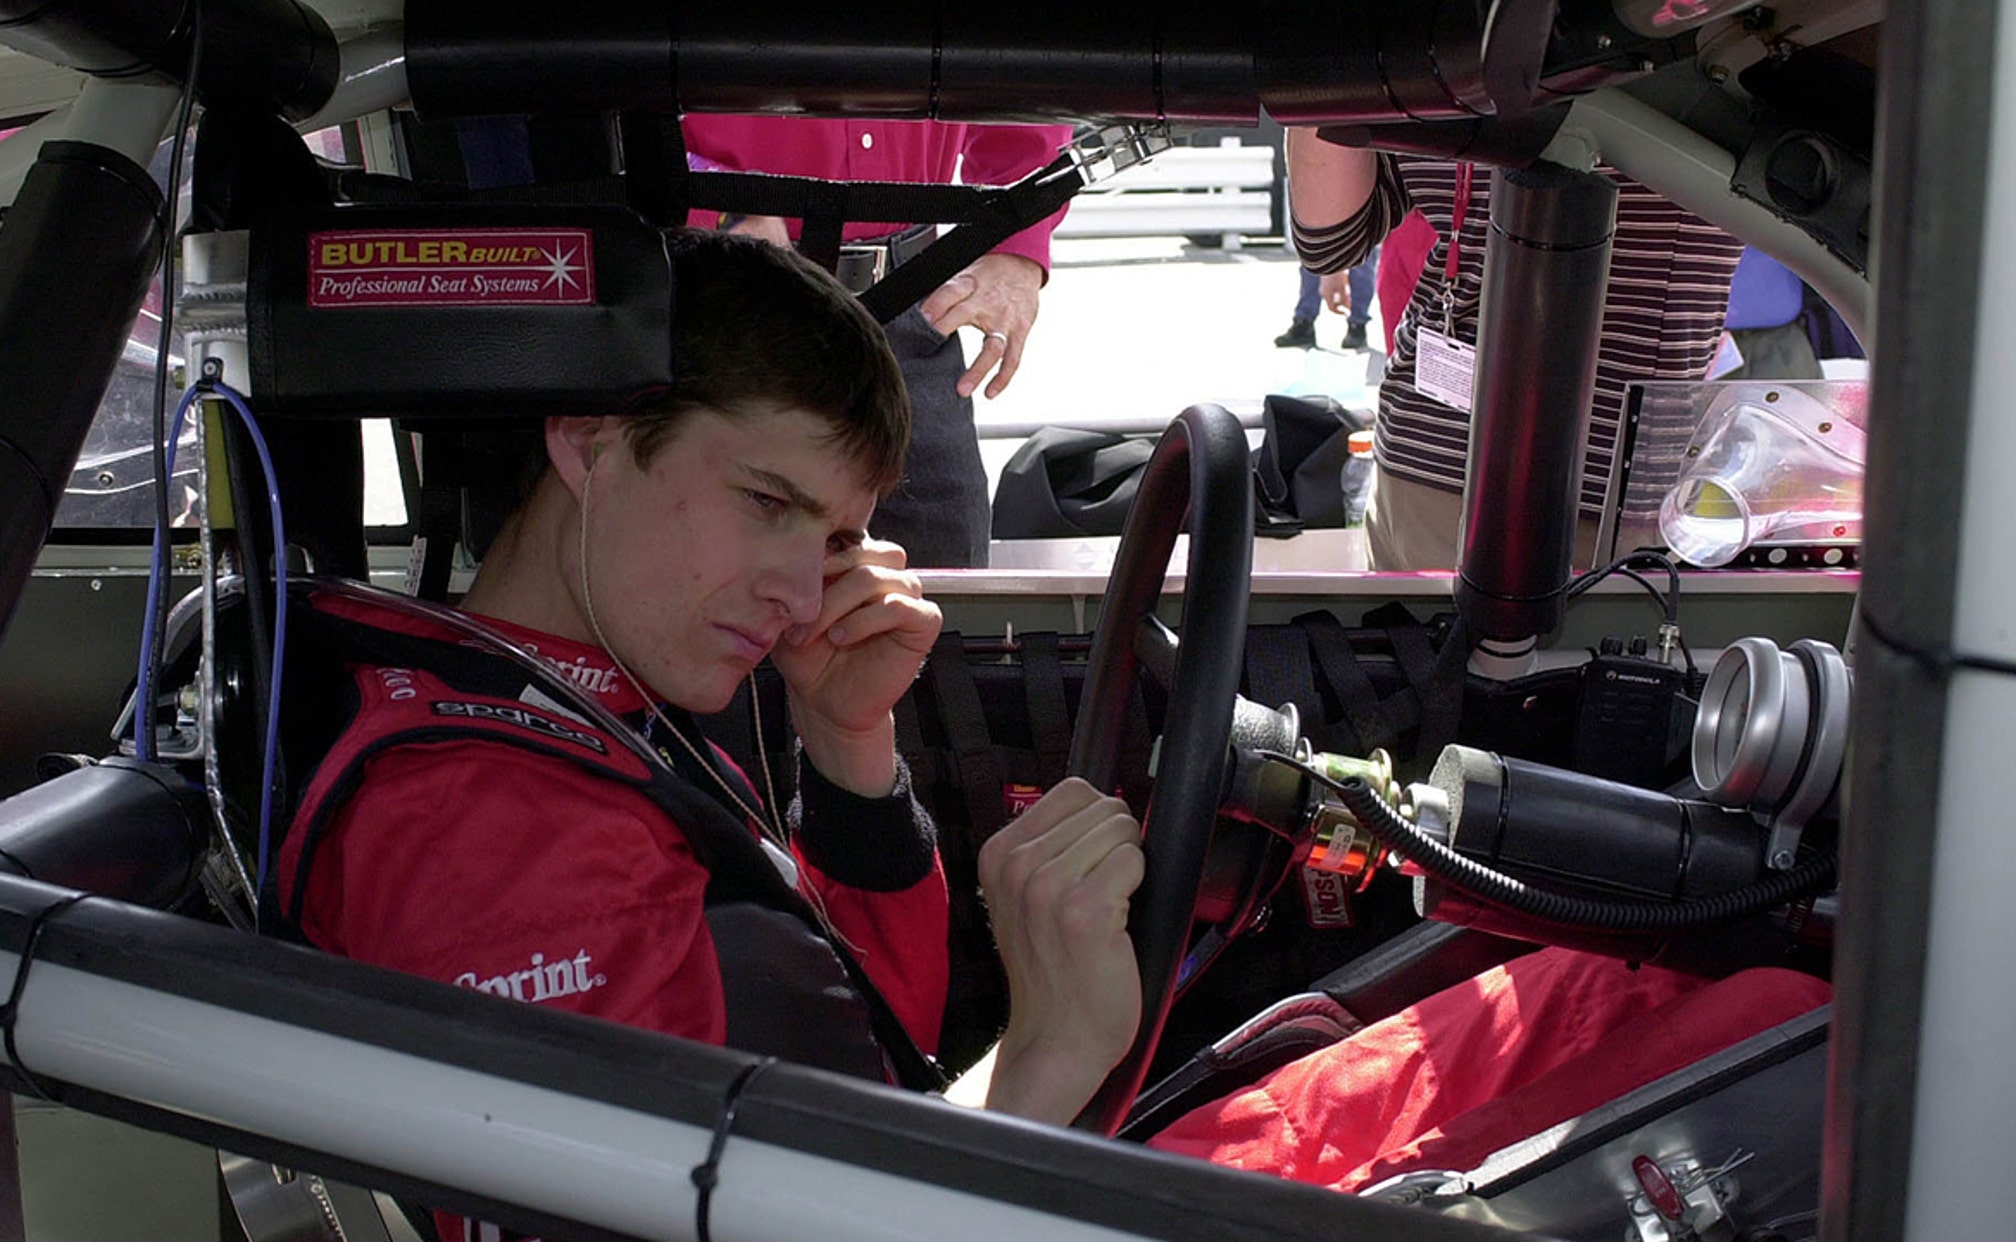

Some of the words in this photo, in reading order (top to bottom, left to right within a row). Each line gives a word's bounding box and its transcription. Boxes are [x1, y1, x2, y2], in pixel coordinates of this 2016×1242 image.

[321, 241, 468, 264] BUTLER
[318, 275, 426, 299] Professional
[428, 276, 467, 293] Seat
[470, 275, 539, 296] Systems
[523, 643, 618, 692] rint
[436, 702, 603, 751] sparco
